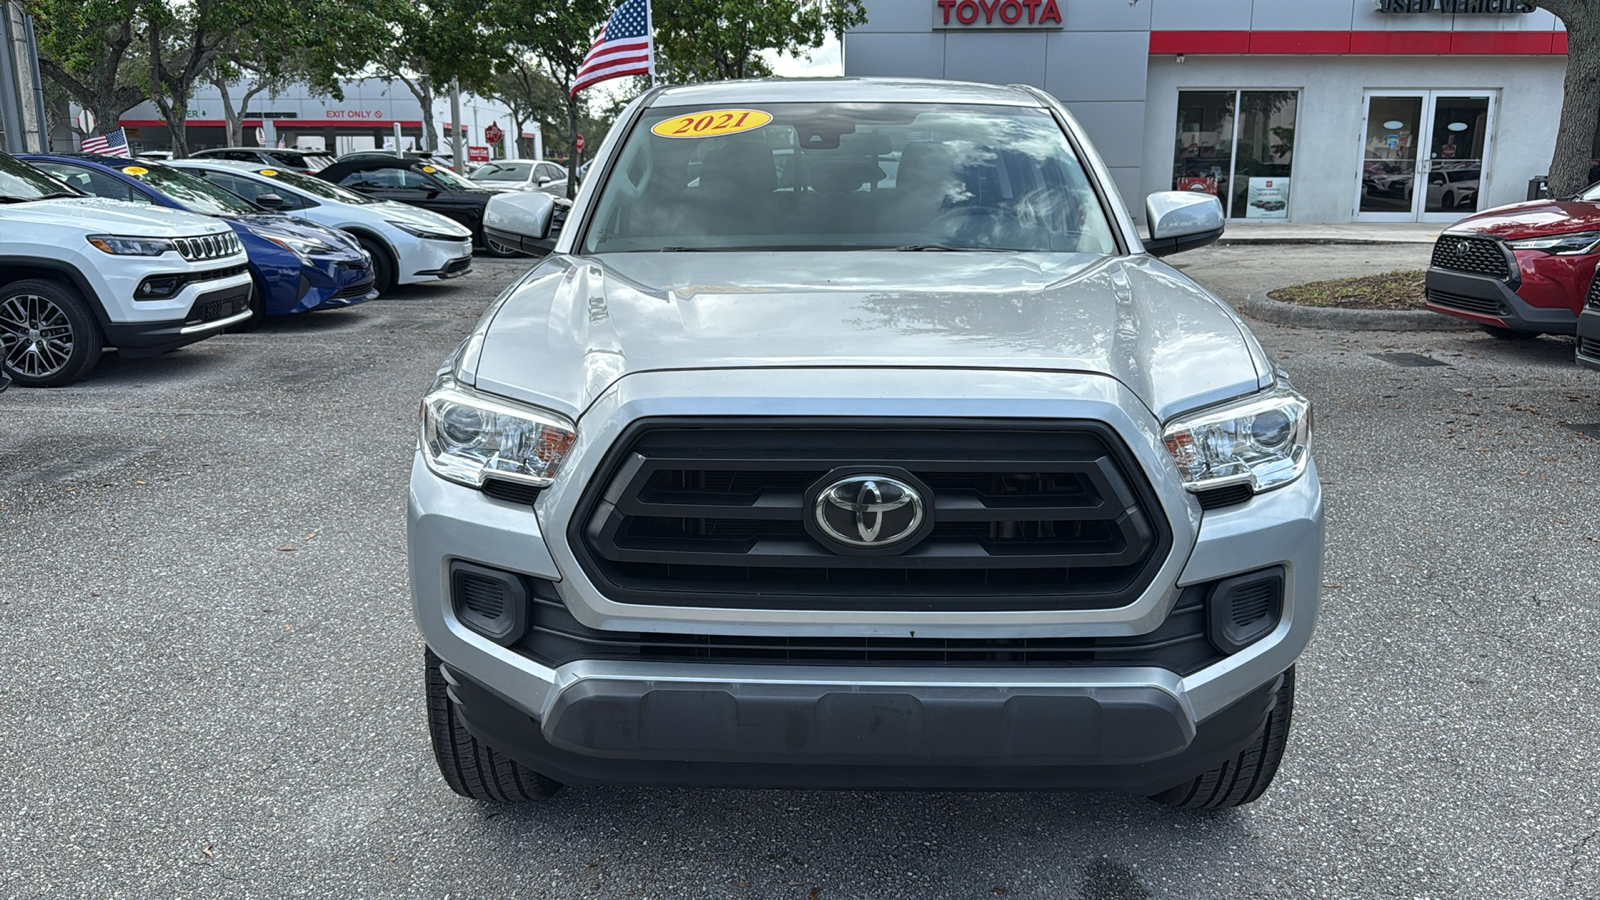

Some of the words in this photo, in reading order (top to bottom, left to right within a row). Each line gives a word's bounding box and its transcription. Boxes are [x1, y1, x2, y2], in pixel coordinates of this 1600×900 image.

[937, 0, 1063, 25] TOYOTA
[326, 110, 345, 119] EXIT
[347, 110, 371, 119] ONLY
[671, 112, 751, 135] 2021
